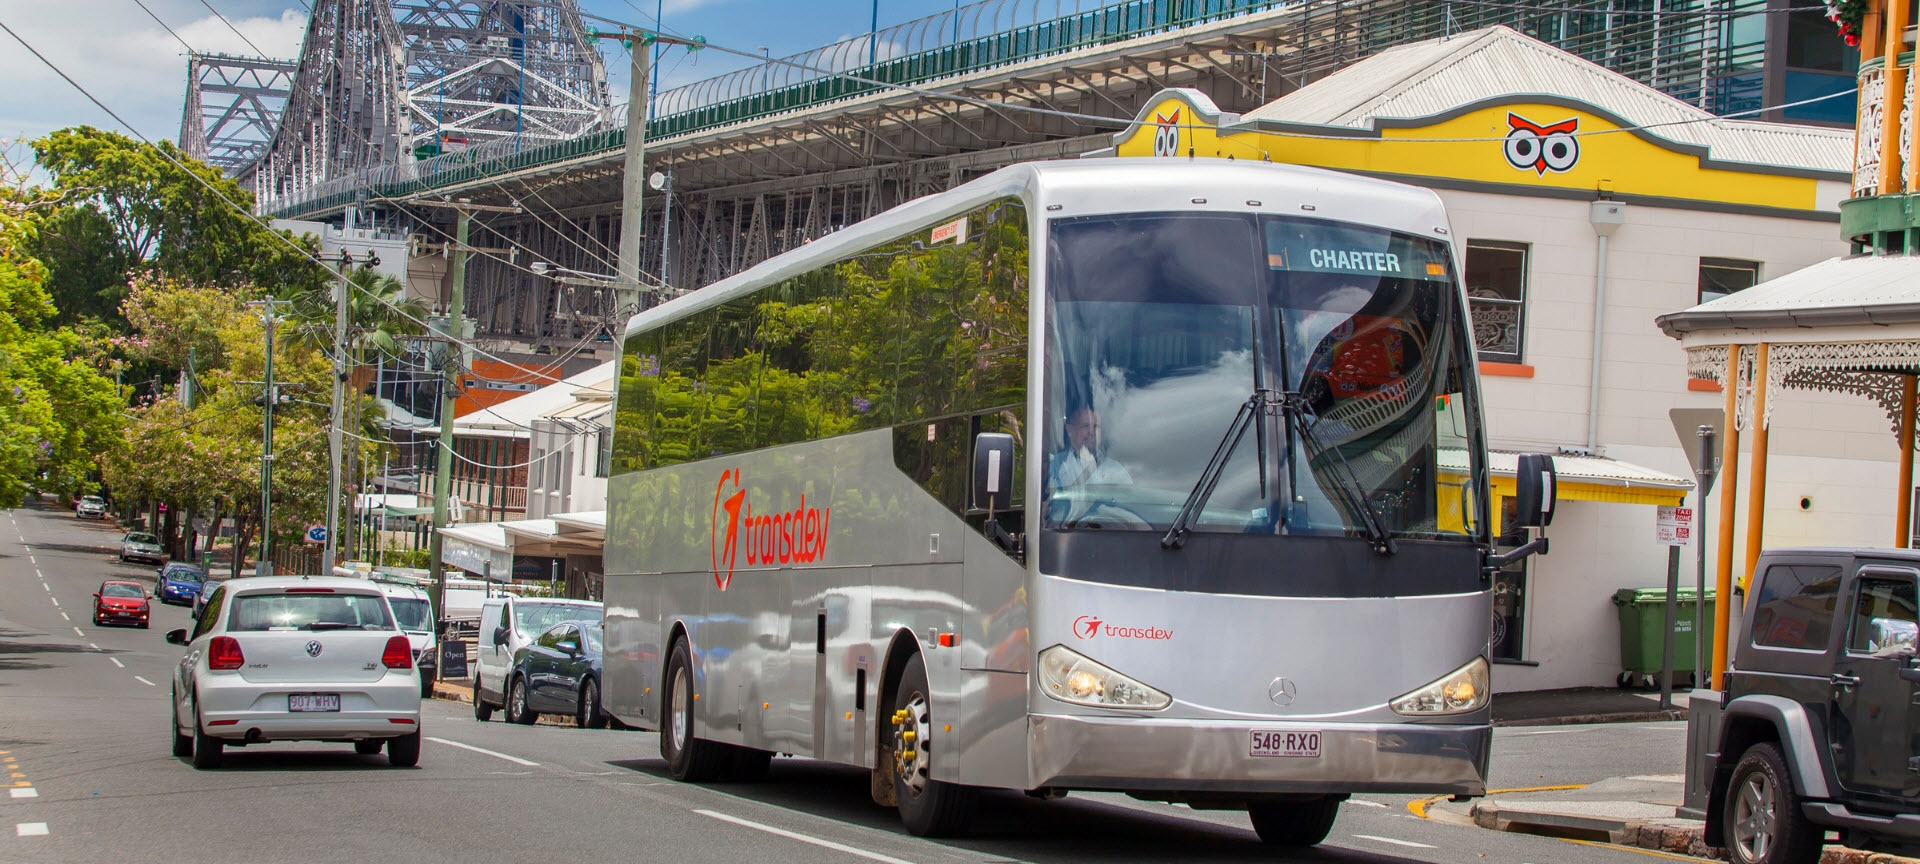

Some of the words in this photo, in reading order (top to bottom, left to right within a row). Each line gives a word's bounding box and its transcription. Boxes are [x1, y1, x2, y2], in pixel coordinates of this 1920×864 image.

[1309, 248, 1401, 272] CHARTER
[744, 493, 830, 566] transdev
[1104, 624, 1174, 640] transdev
[445, 651, 464, 660] Open
